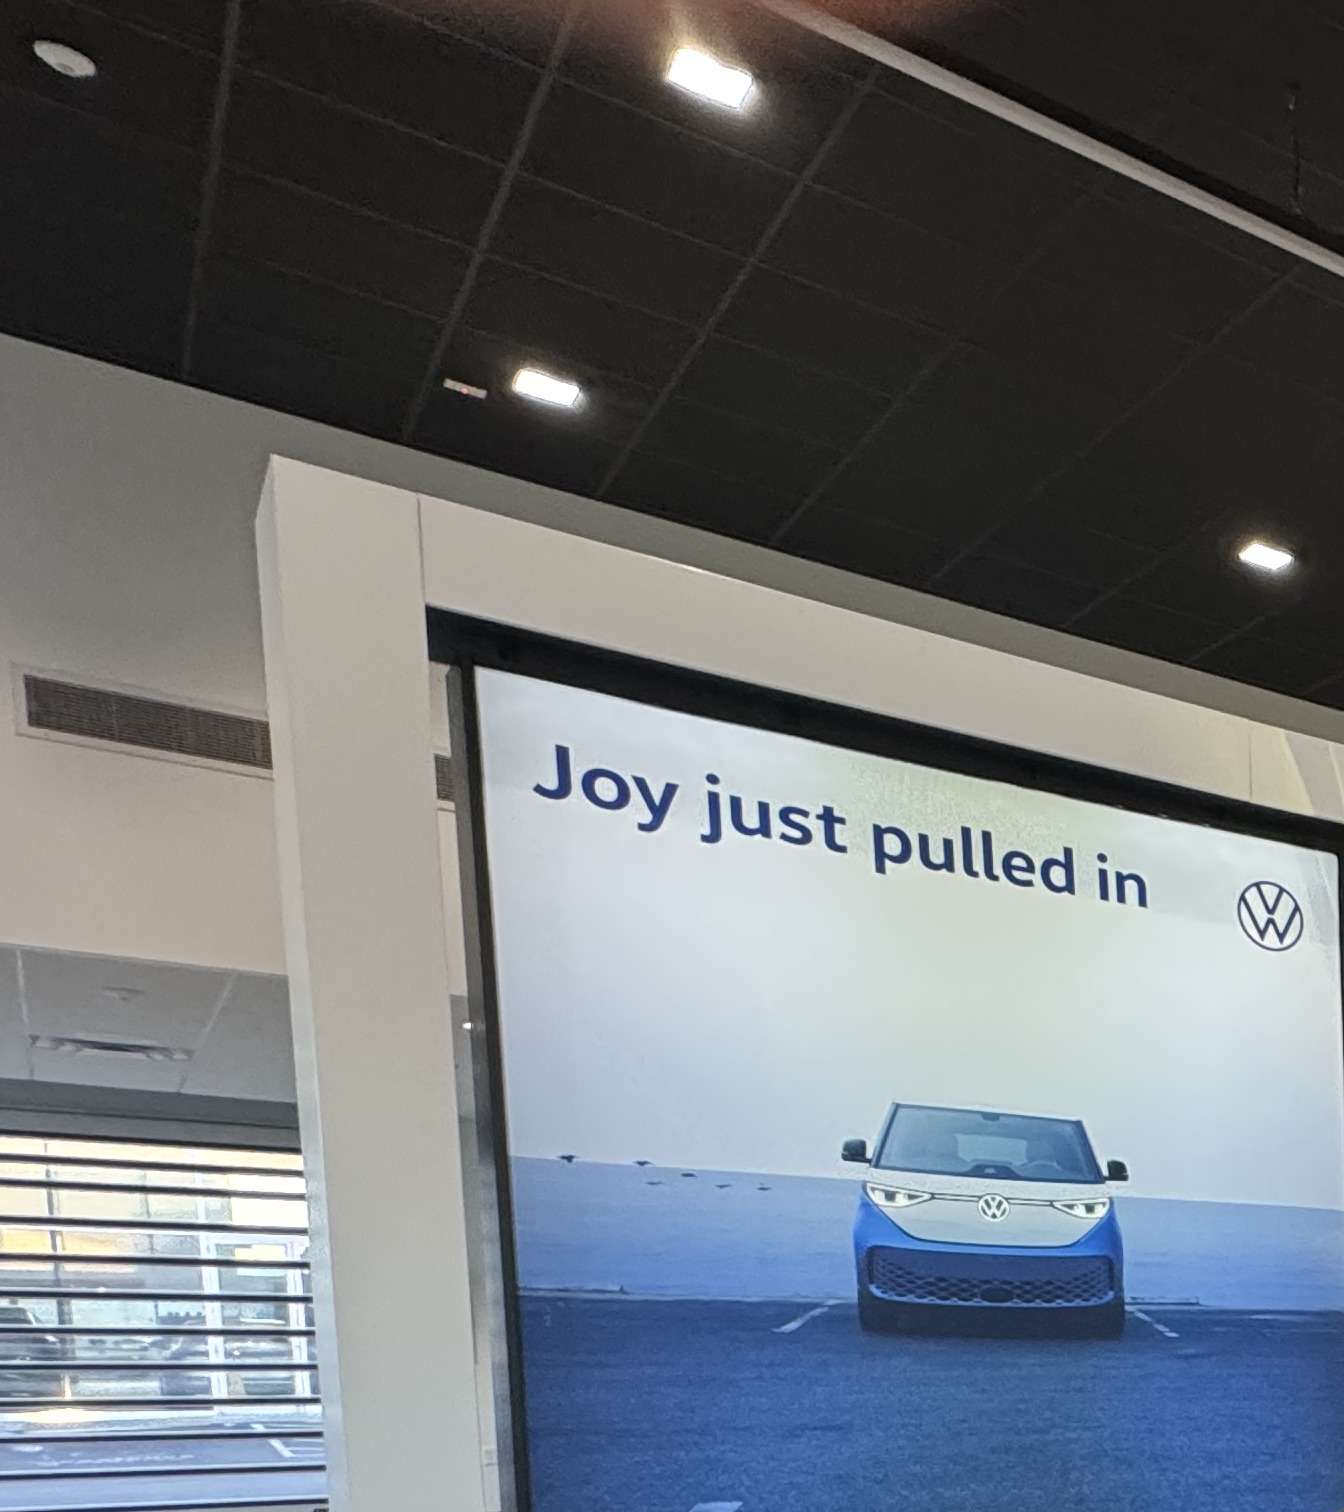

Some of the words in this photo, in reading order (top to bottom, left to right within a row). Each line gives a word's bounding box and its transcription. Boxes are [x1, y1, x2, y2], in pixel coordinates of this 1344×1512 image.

[533, 744, 679, 832] Joy
[700, 773, 848, 854] just
[872, 826, 1076, 896] pulled
[1097, 853, 1150, 909] in
